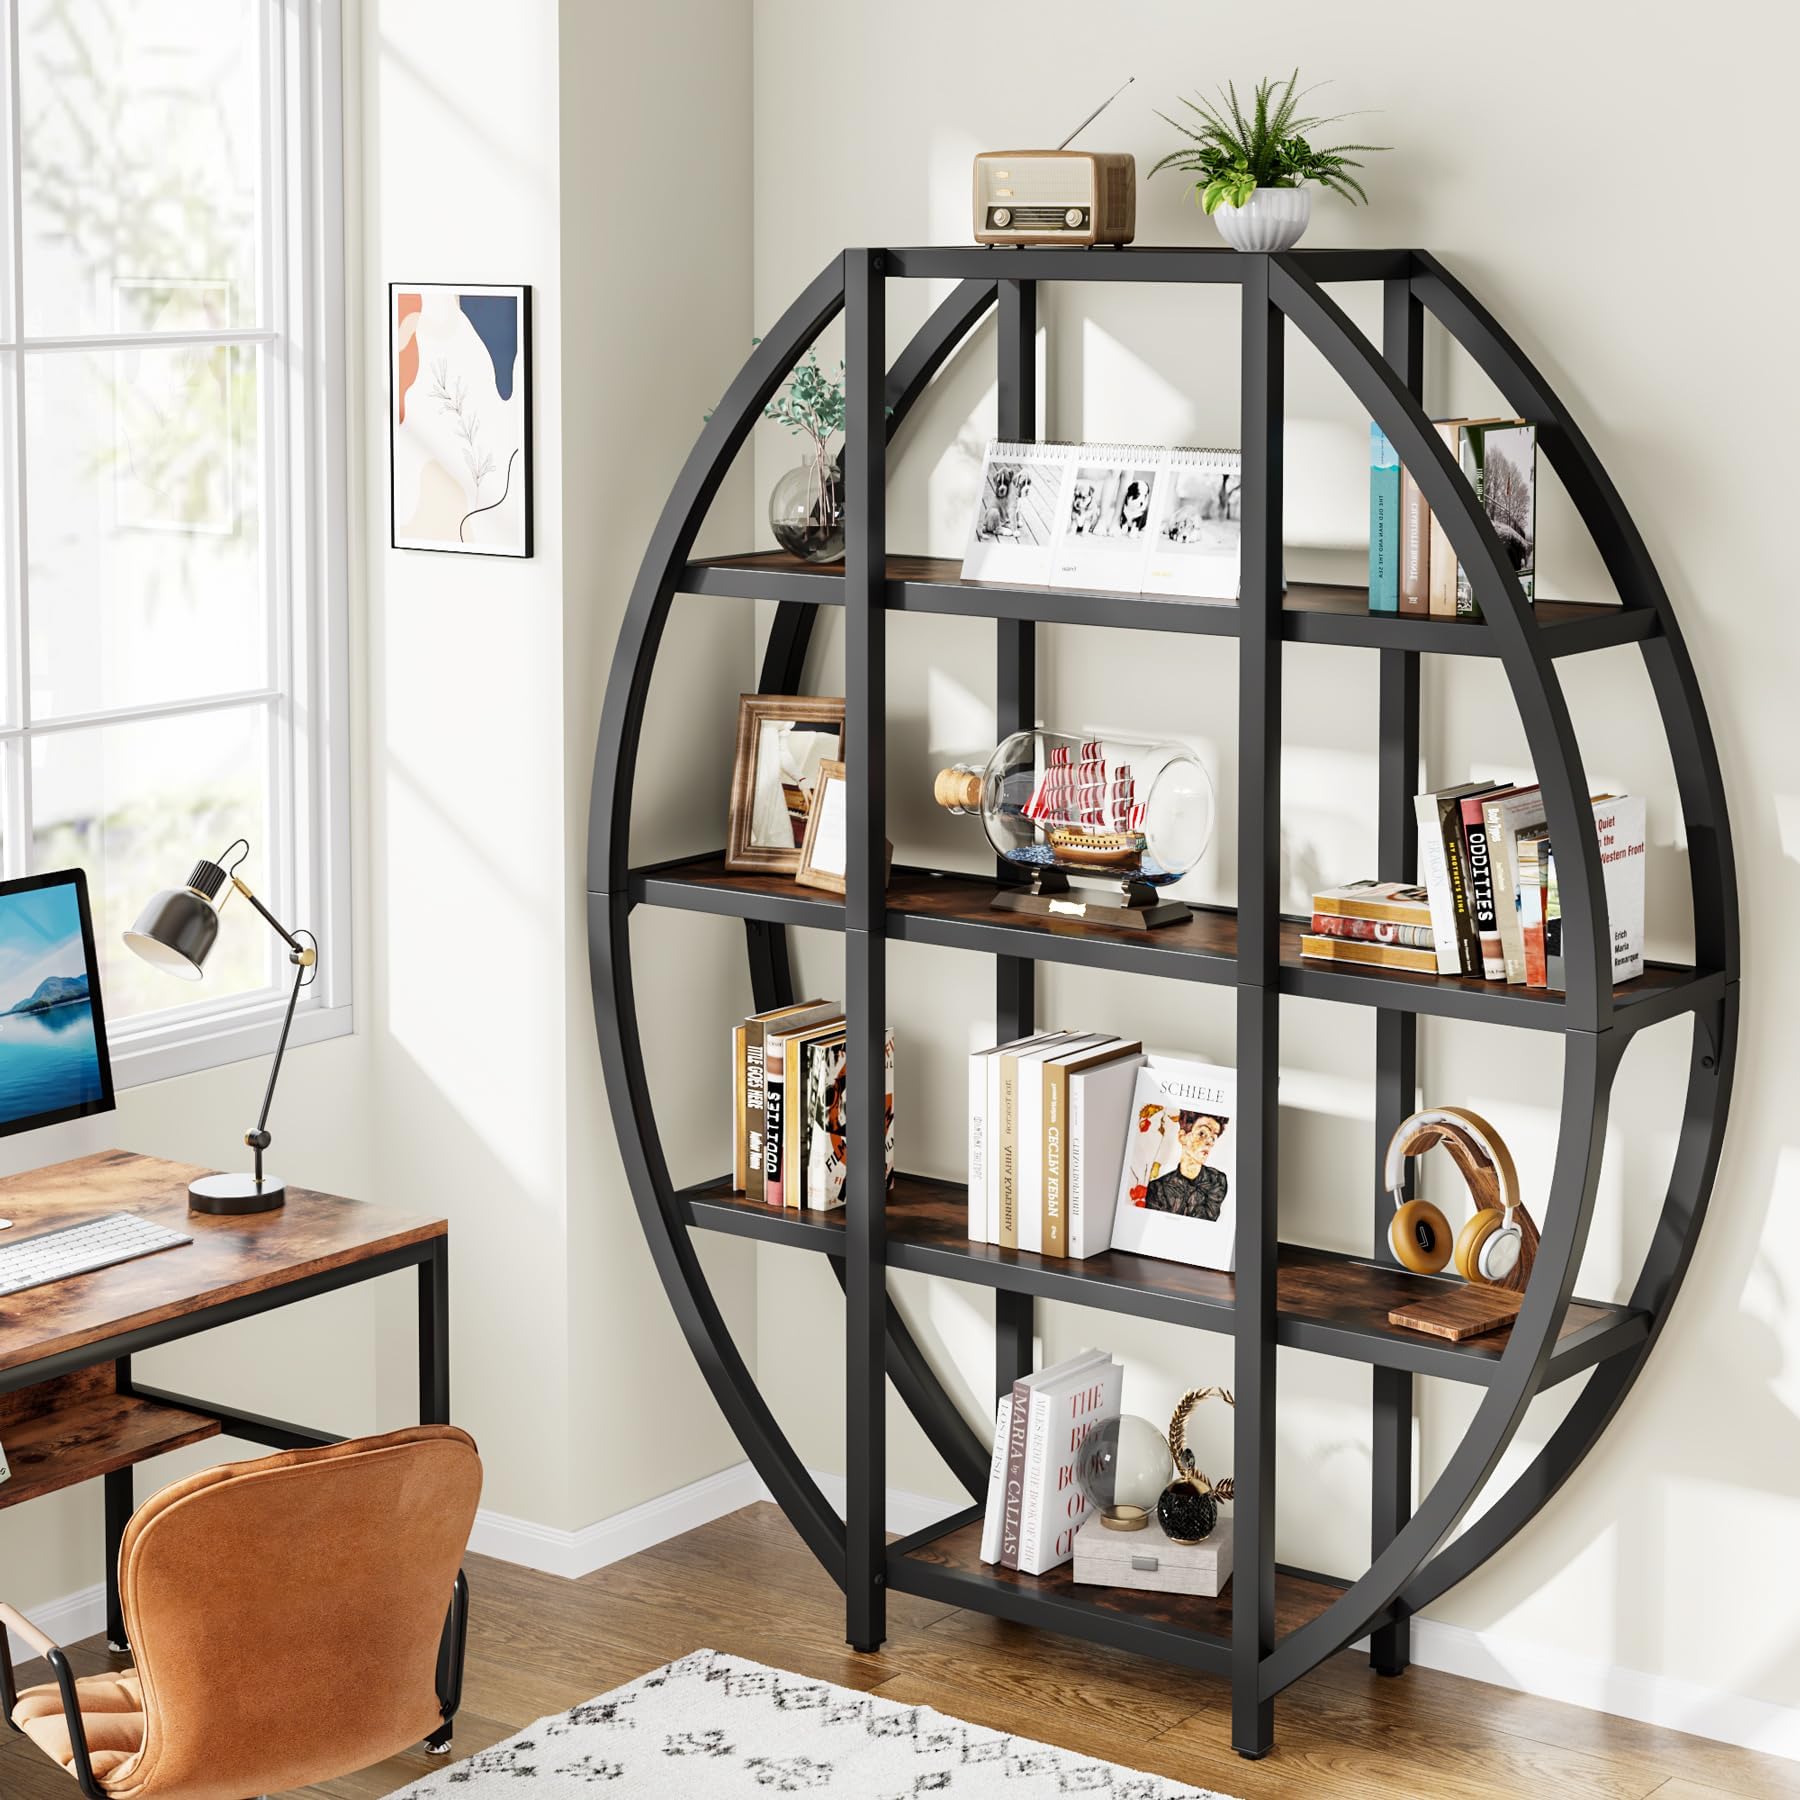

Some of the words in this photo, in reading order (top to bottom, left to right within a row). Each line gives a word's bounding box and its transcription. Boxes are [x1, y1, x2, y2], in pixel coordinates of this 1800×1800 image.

[1598, 815, 1615, 832] Quiet
[1603, 834, 1614, 845] the
[1628, 842, 1645, 857] Front
[1469, 833, 1493, 921] ODDITIES
[1614, 929, 1627, 941] Erich
[1614, 943, 1629, 955] Maria
[1614, 952, 1639, 967] Remarque
[747, 1045, 763, 1065] TITLE
[747, 1065, 763, 1088] GOES
[747, 1089, 763, 1110] HERE
[1159, 1080, 1225, 1103] SCHIELE
[767, 1091, 781, 1173] ODDITIES
[1070, 1383, 1104, 1419] THE
[998, 1403, 1009, 1440] LOST
[1012, 1395, 1028, 1460] MARIA
[992, 1446, 1004, 1480] FISH
[1011, 1464, 1020, 1475] by
[1004, 1480, 1021, 1555] CALLAS
